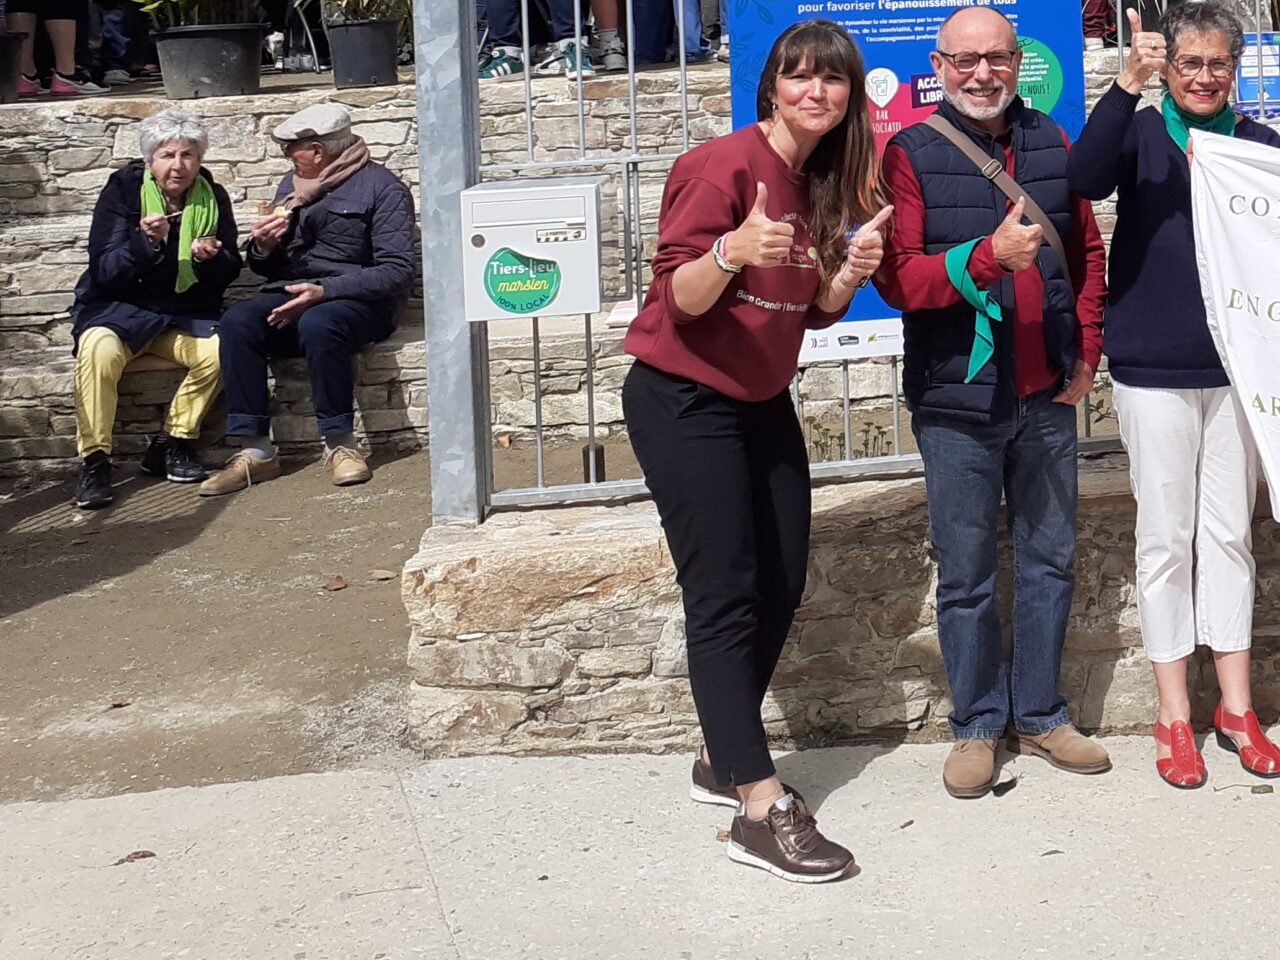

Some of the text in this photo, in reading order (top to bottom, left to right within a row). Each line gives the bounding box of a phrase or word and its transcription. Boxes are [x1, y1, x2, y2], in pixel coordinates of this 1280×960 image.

[798, 3, 824, 15] pour
[827, 0, 875, 12] favoriser
[490, 259, 554, 278] Tiers-lieu
[497, 278, 550, 292] marsien
[496, 293, 550, 311] 100% LOCAL
